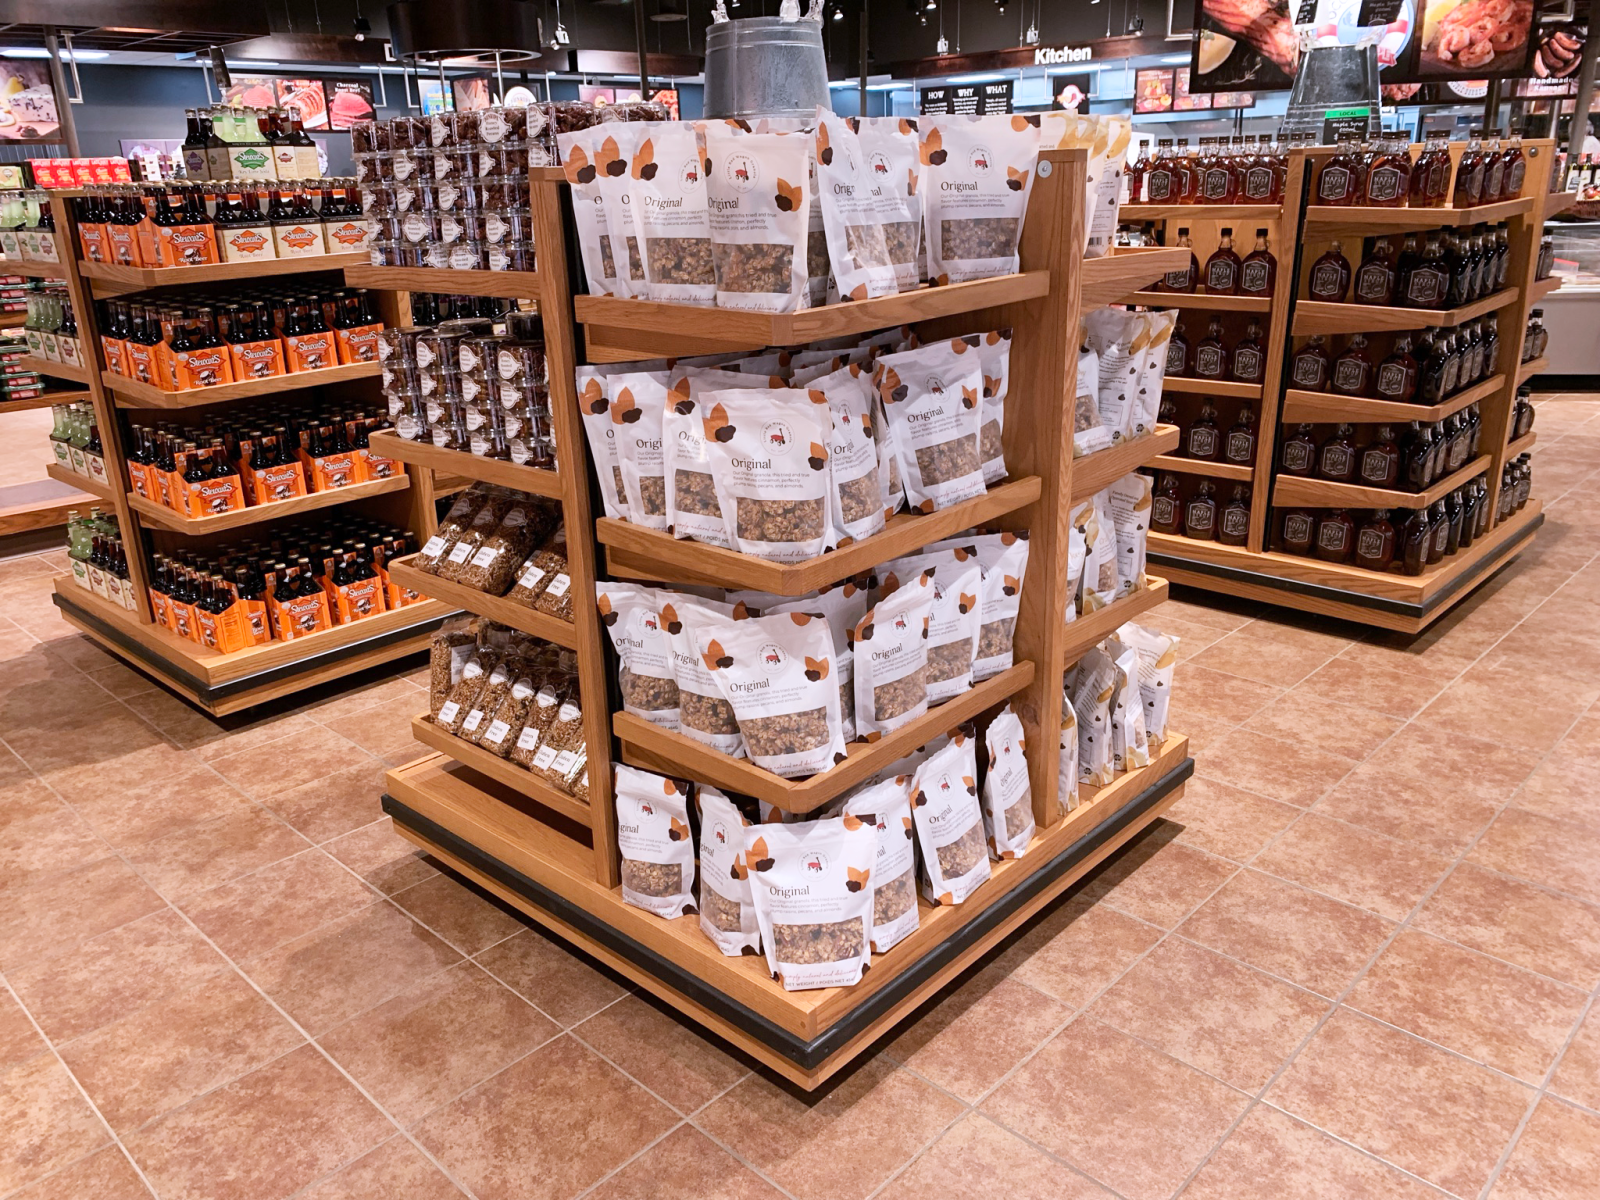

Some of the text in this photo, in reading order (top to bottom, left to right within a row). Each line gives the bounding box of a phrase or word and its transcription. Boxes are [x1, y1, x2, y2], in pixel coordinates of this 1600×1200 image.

[1035, 46, 1092, 65] Kitchen
[928, 91, 944, 99] HOW
[957, 88, 974, 97] WHY
[986, 85, 1007, 94] WHAT
[941, 181, 978, 193] Original
[644, 196, 683, 210] Original
[708, 197, 739, 212] Original
[908, 406, 944, 423] Original
[636, 438, 662, 450] Origi
[732, 458, 771, 471] Original
[871, 643, 903, 662] Original
[730, 678, 770, 693] Original
[770, 885, 810, 899] Original
